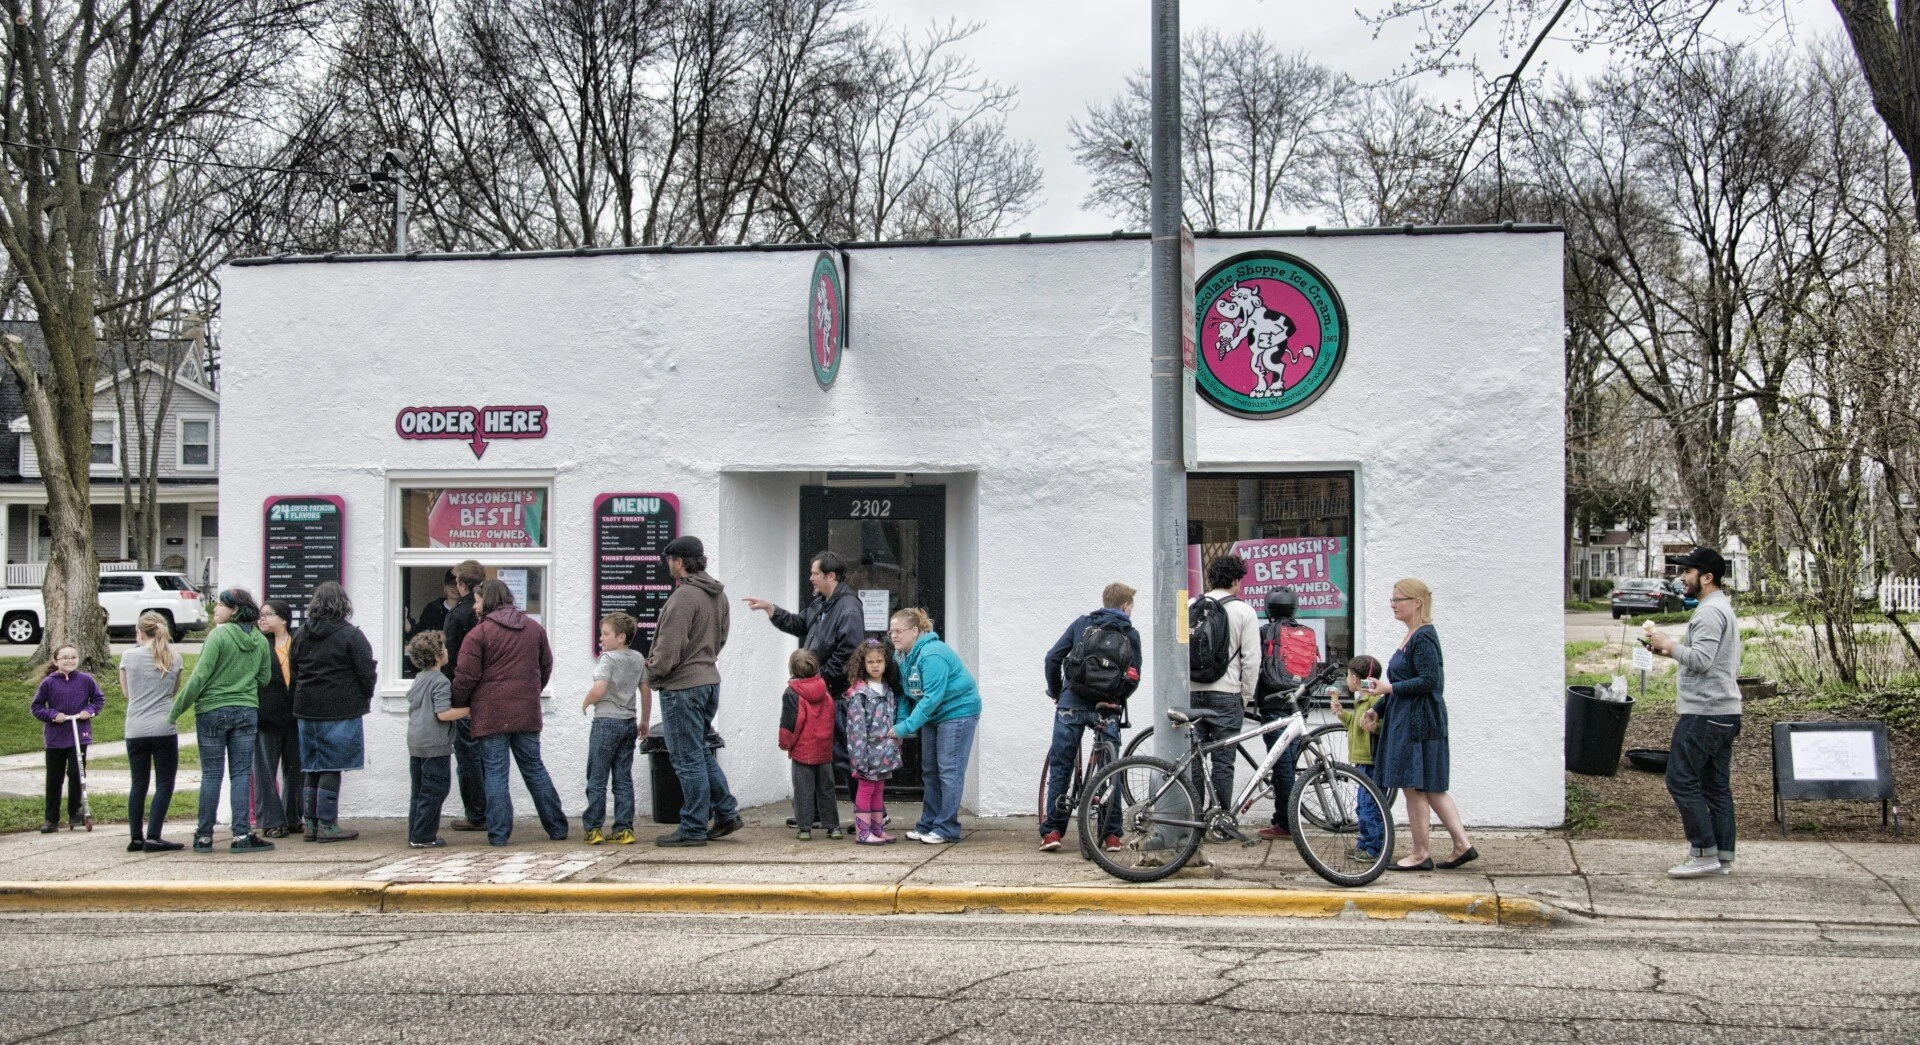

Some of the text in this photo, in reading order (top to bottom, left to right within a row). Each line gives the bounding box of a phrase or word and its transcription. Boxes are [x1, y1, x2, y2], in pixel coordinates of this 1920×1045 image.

[1195, 275, 1233, 327] hocolate
[1236, 265, 1286, 277] Shoppe
[1289, 270, 1307, 287] Ice
[1269, 385, 1309, 405] Wisconsin
[1307, 352, 1332, 385] Goodness
[401, 410, 542, 434] ORDER HERE
[448, 491, 533, 505] WISCONSIN'S
[612, 498, 660, 513] MENU
[270, 504, 336, 520] 24 SUPER PREMIUM
[460, 503, 521, 526] BEST!
[850, 500, 891, 517] 2302
[449, 529, 482, 539] FAMILY
[1239, 539, 1336, 560] WISCONSIN'S
[1254, 554, 1325, 582] BEST!
[1244, 585, 1282, 595] FAMI
[1298, 595, 1338, 606] MADE.
